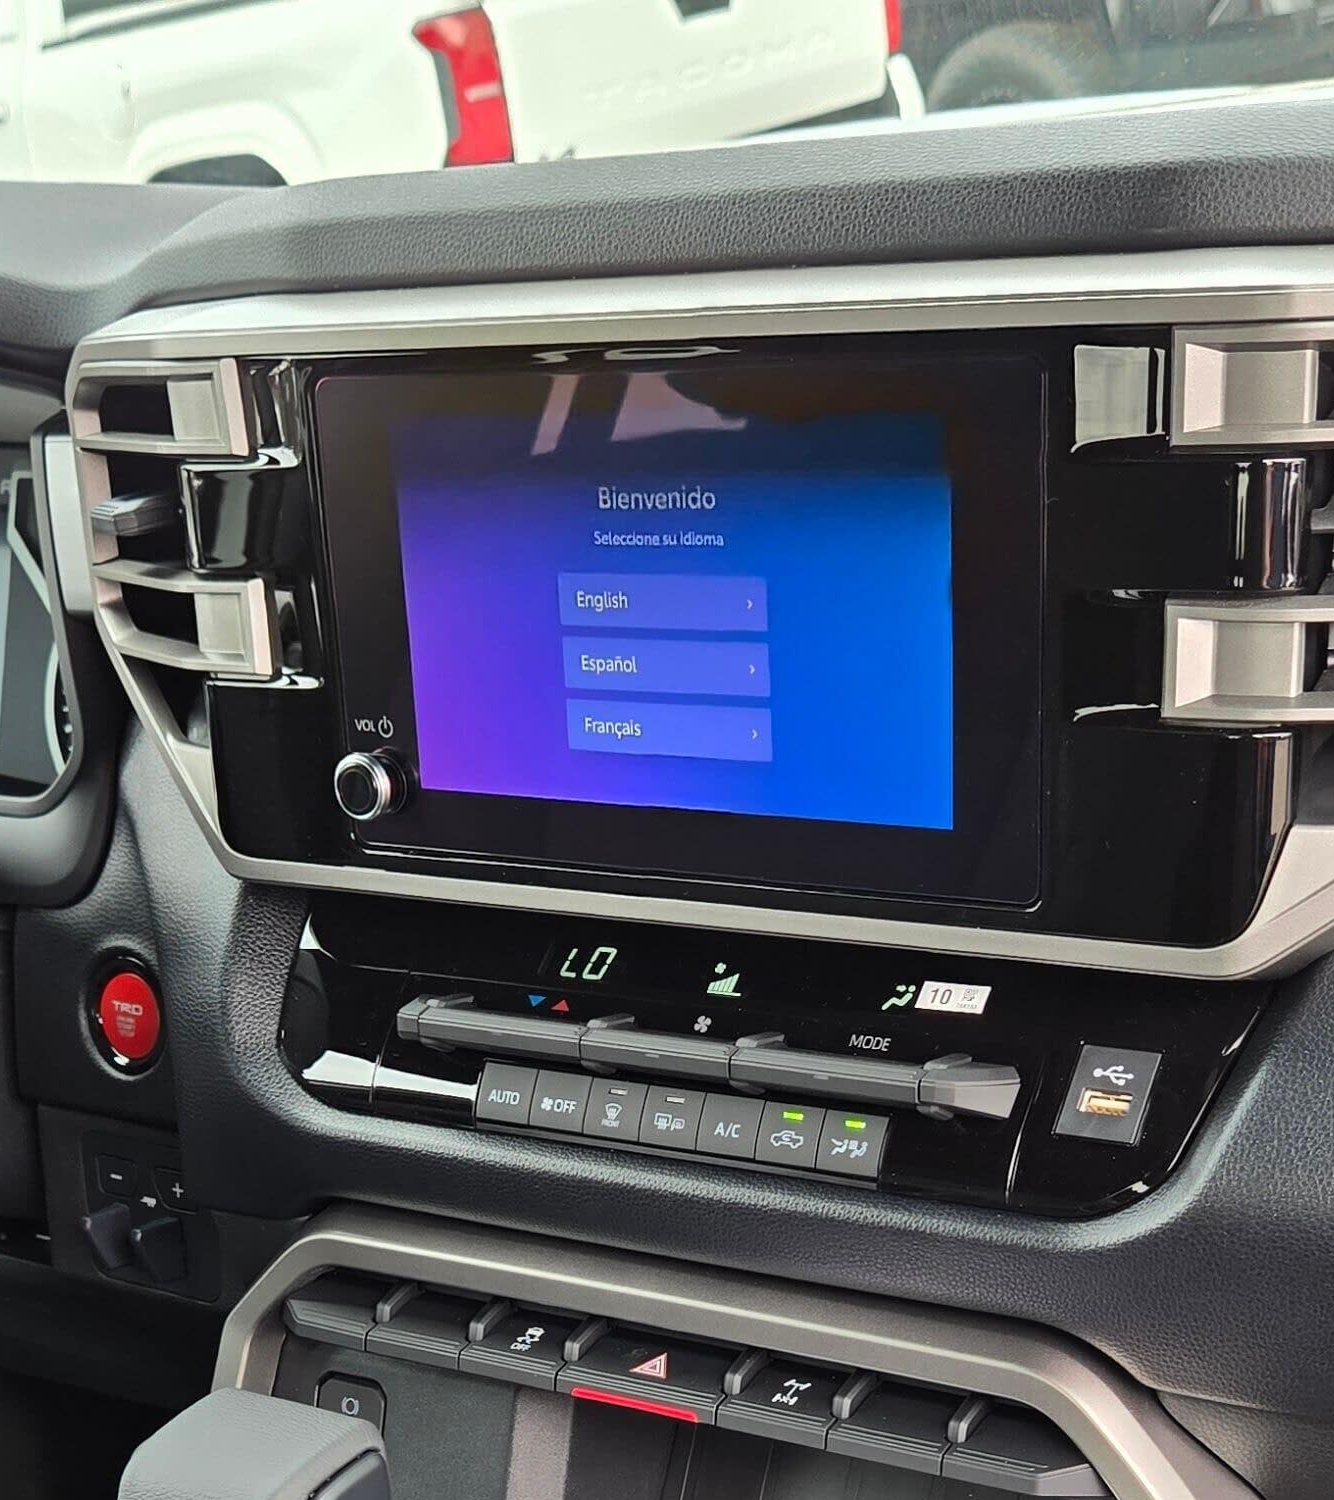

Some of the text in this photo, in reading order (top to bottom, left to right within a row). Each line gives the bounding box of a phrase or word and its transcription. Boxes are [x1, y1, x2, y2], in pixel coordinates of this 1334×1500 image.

[598, 486, 716, 510] Bienvenido
[593, 531, 725, 547] Seleccione su idioma
[576, 590, 629, 613] English
[581, 654, 638, 675] Español
[354, 718, 376, 732] VOL
[584, 717, 642, 740] Français
[929, 988, 953, 1005] 10
[111, 1000, 144, 1016] TRD
[848, 1034, 892, 1052] MODE
[488, 1089, 520, 1106] AUTO
[553, 1099, 577, 1114] OFF
[714, 1121, 742, 1138] A/C
